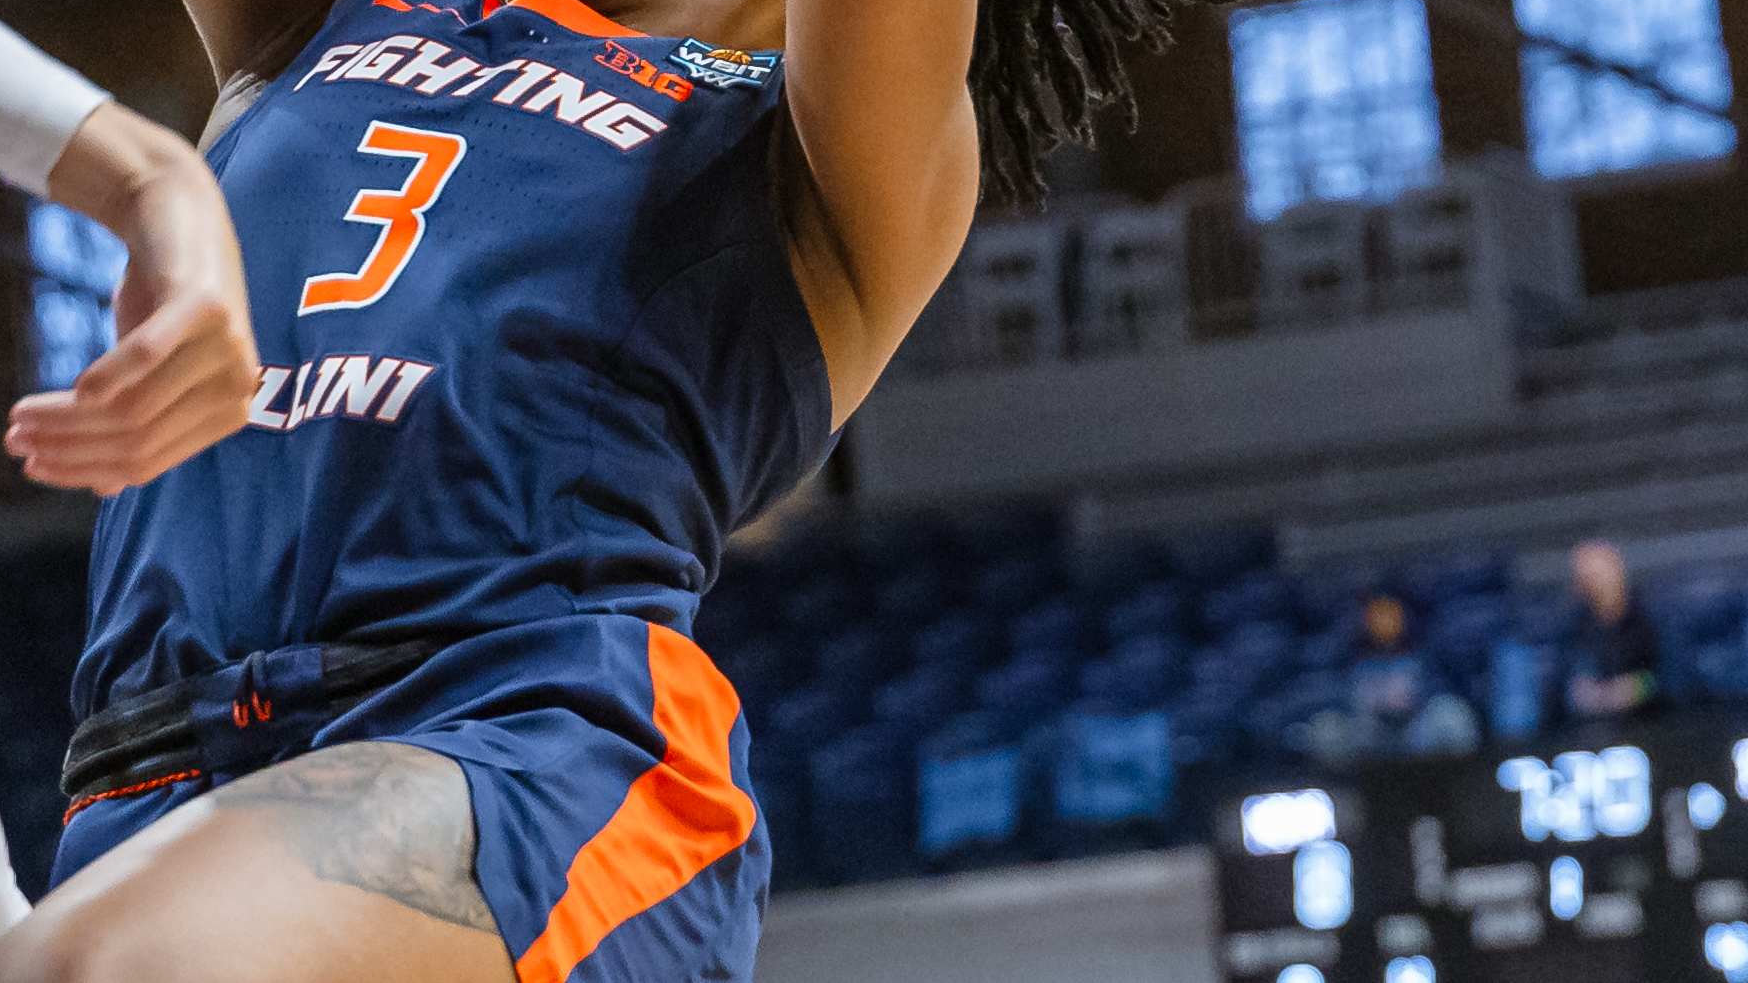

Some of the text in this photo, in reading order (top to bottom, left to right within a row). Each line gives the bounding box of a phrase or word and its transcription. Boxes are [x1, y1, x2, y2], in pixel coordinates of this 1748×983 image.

[293, 34, 669, 152] FIGHTING
[678, 45, 773, 80] WBIT
[297, 119, 468, 318] 3
[246, 352, 437, 431] LLINI
